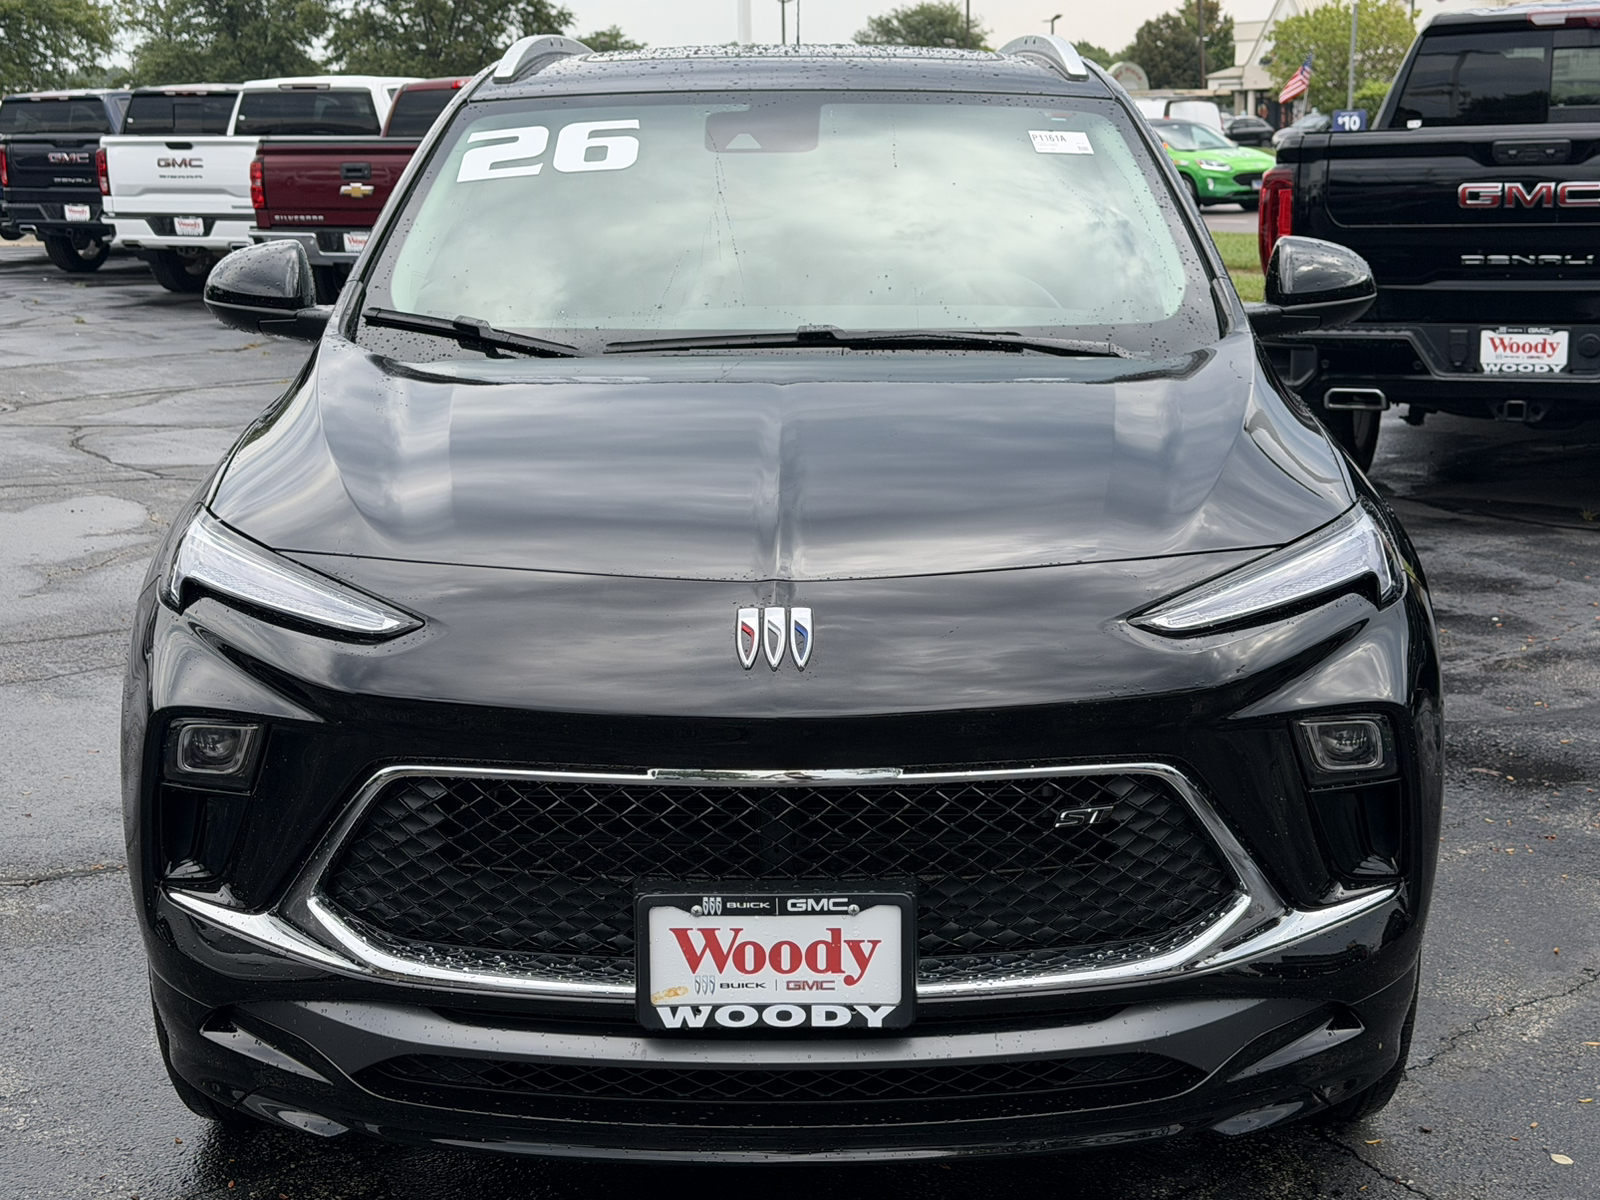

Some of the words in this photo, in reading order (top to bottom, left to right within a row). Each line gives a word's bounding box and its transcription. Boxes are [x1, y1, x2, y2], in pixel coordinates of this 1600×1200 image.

[1337, 115, 1361, 131] $10
[1031, 133, 1067, 143] P1161A
[48, 152, 89, 164] GMC
[456, 119, 640, 183] 26
[157, 157, 204, 168] GMC
[1457, 182, 1600, 208] GMC
[1460, 254, 1594, 264] DENALI
[1489, 337, 1561, 358] Woody
[1482, 363, 1567, 373] WOODY
[1054, 805, 1114, 828] ST
[726, 901, 771, 909] BUICK
[786, 898, 849, 912] GMC
[668, 927, 882, 987] Woody
[719, 981, 767, 989] BUICK
[786, 980, 836, 991] GMC
[655, 1004, 897, 1028] WOODY
